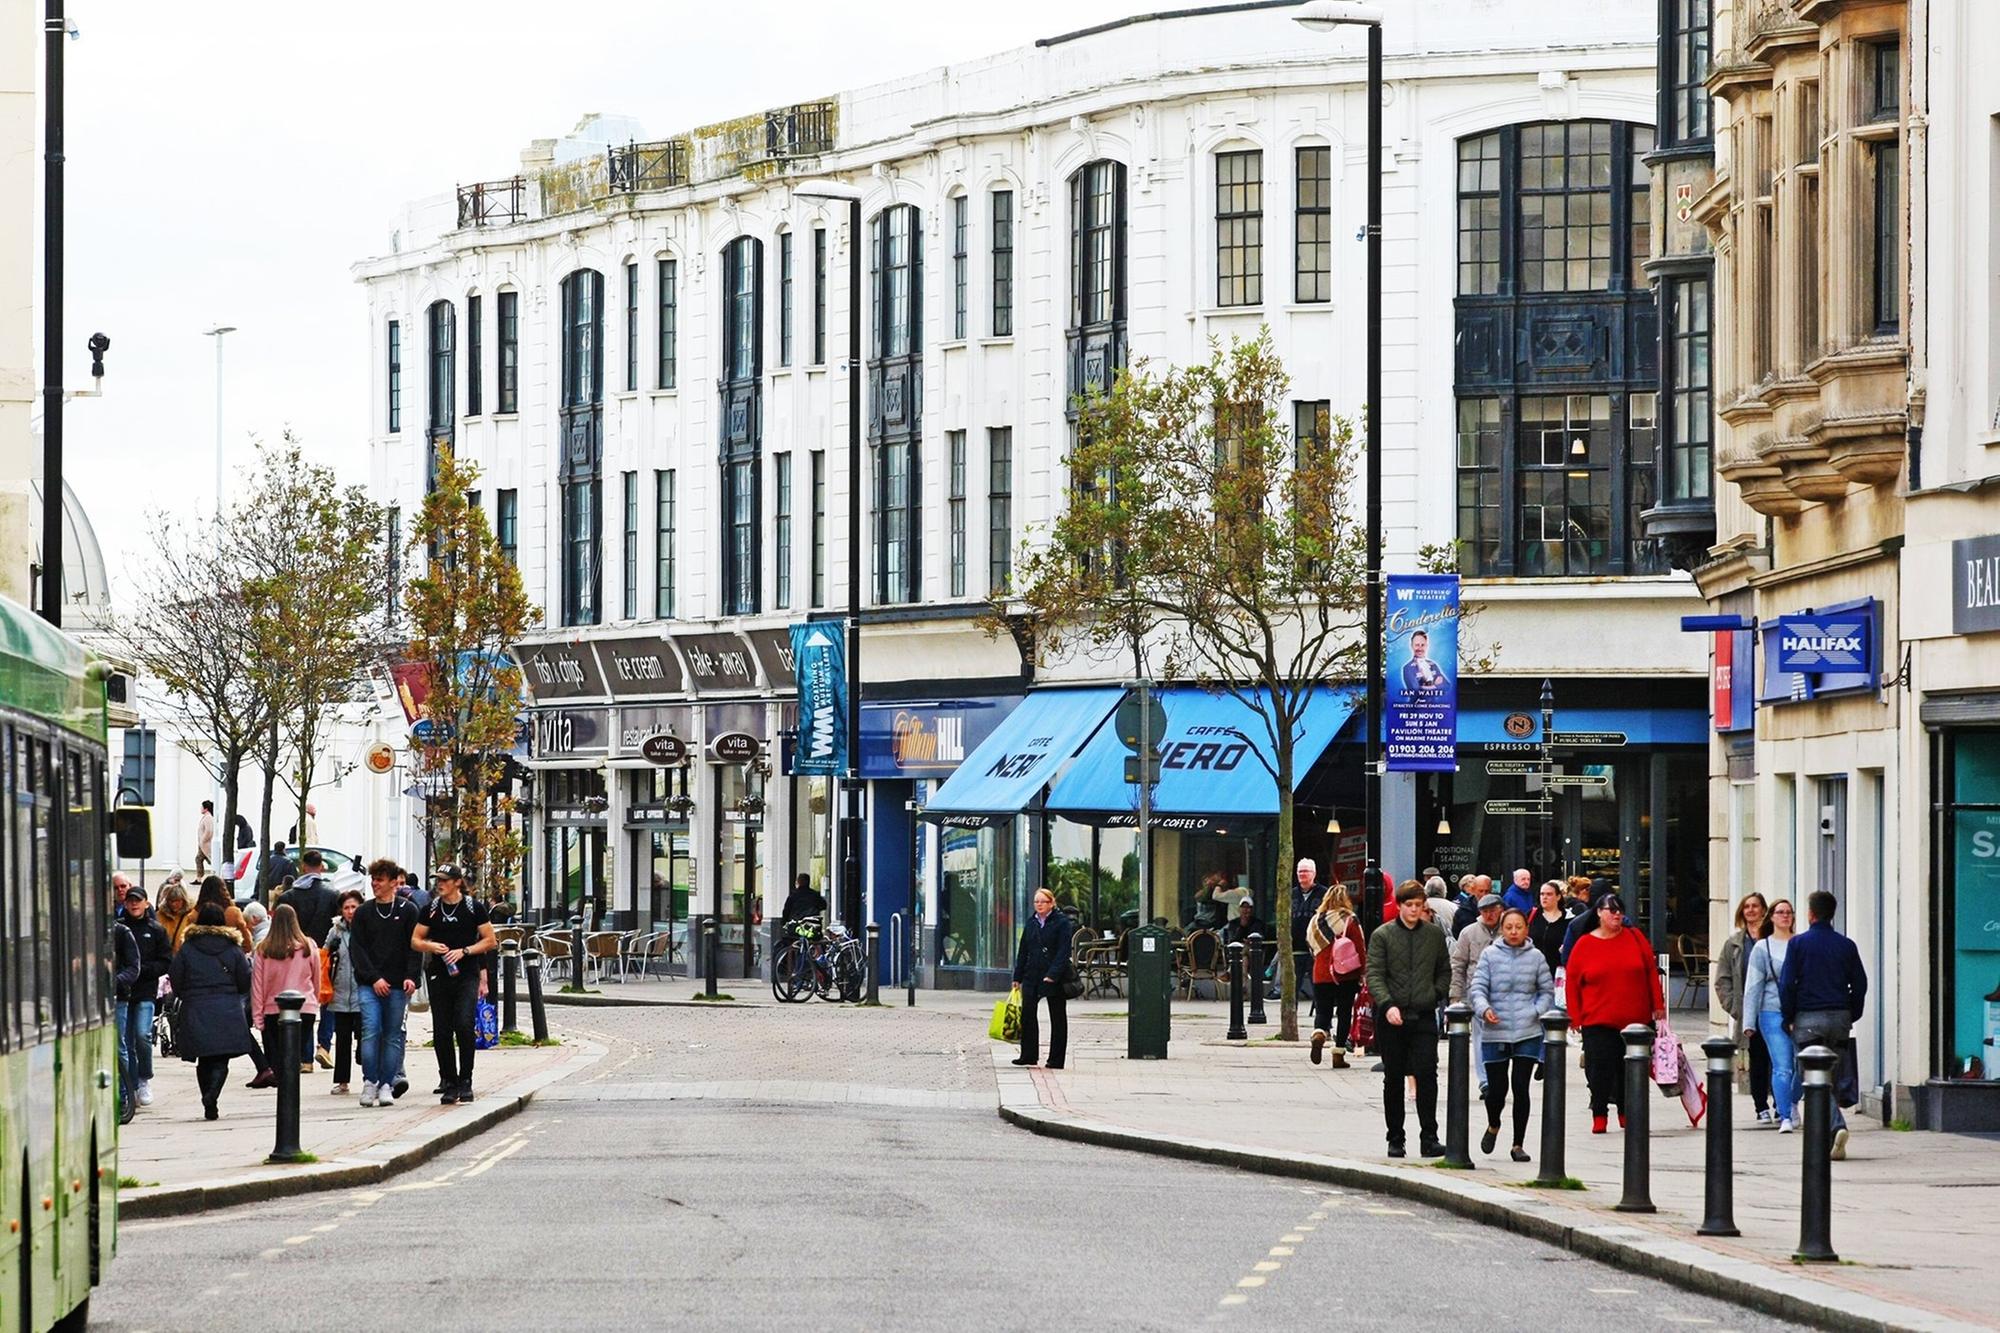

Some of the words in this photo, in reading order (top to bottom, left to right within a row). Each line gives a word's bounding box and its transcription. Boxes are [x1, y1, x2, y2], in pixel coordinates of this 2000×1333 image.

[1396, 588, 1415, 600] WT
[1967, 557, 2000, 608] BEAL
[1388, 603, 1458, 634] Cinderella
[774, 639, 796, 672] ba
[1782, 637, 1862, 651] HALIFAX
[533, 653, 555, 684] fish
[559, 652, 584, 690] chips
[612, 650, 633, 681] ice
[631, 655, 664, 680] cream
[687, 645, 715, 677] take
[718, 652, 750, 683] away
[822, 646, 832, 684] GALLERY
[811, 662, 820, 709] WORTHING
[818, 670, 827, 706] MUSEUM
[543, 710, 572, 752] vita
[654, 738, 675, 750] vita
[727, 736, 748, 748] vita
[893, 711, 937, 762] William
[937, 717, 965, 761] HILL
[1389, 745, 1416, 753] 01903
[1418, 745, 1435, 753] 206
[1437, 745, 1454, 753] 206
[1484, 743, 1531, 751] ESPRESSO
[985, 752, 1048, 780] NERO
[1162, 818, 1195, 829] COFFEE
[1434, 846, 1474, 854] ADDITIONAL
[1439, 863, 1470, 871] UPSTAIRS
